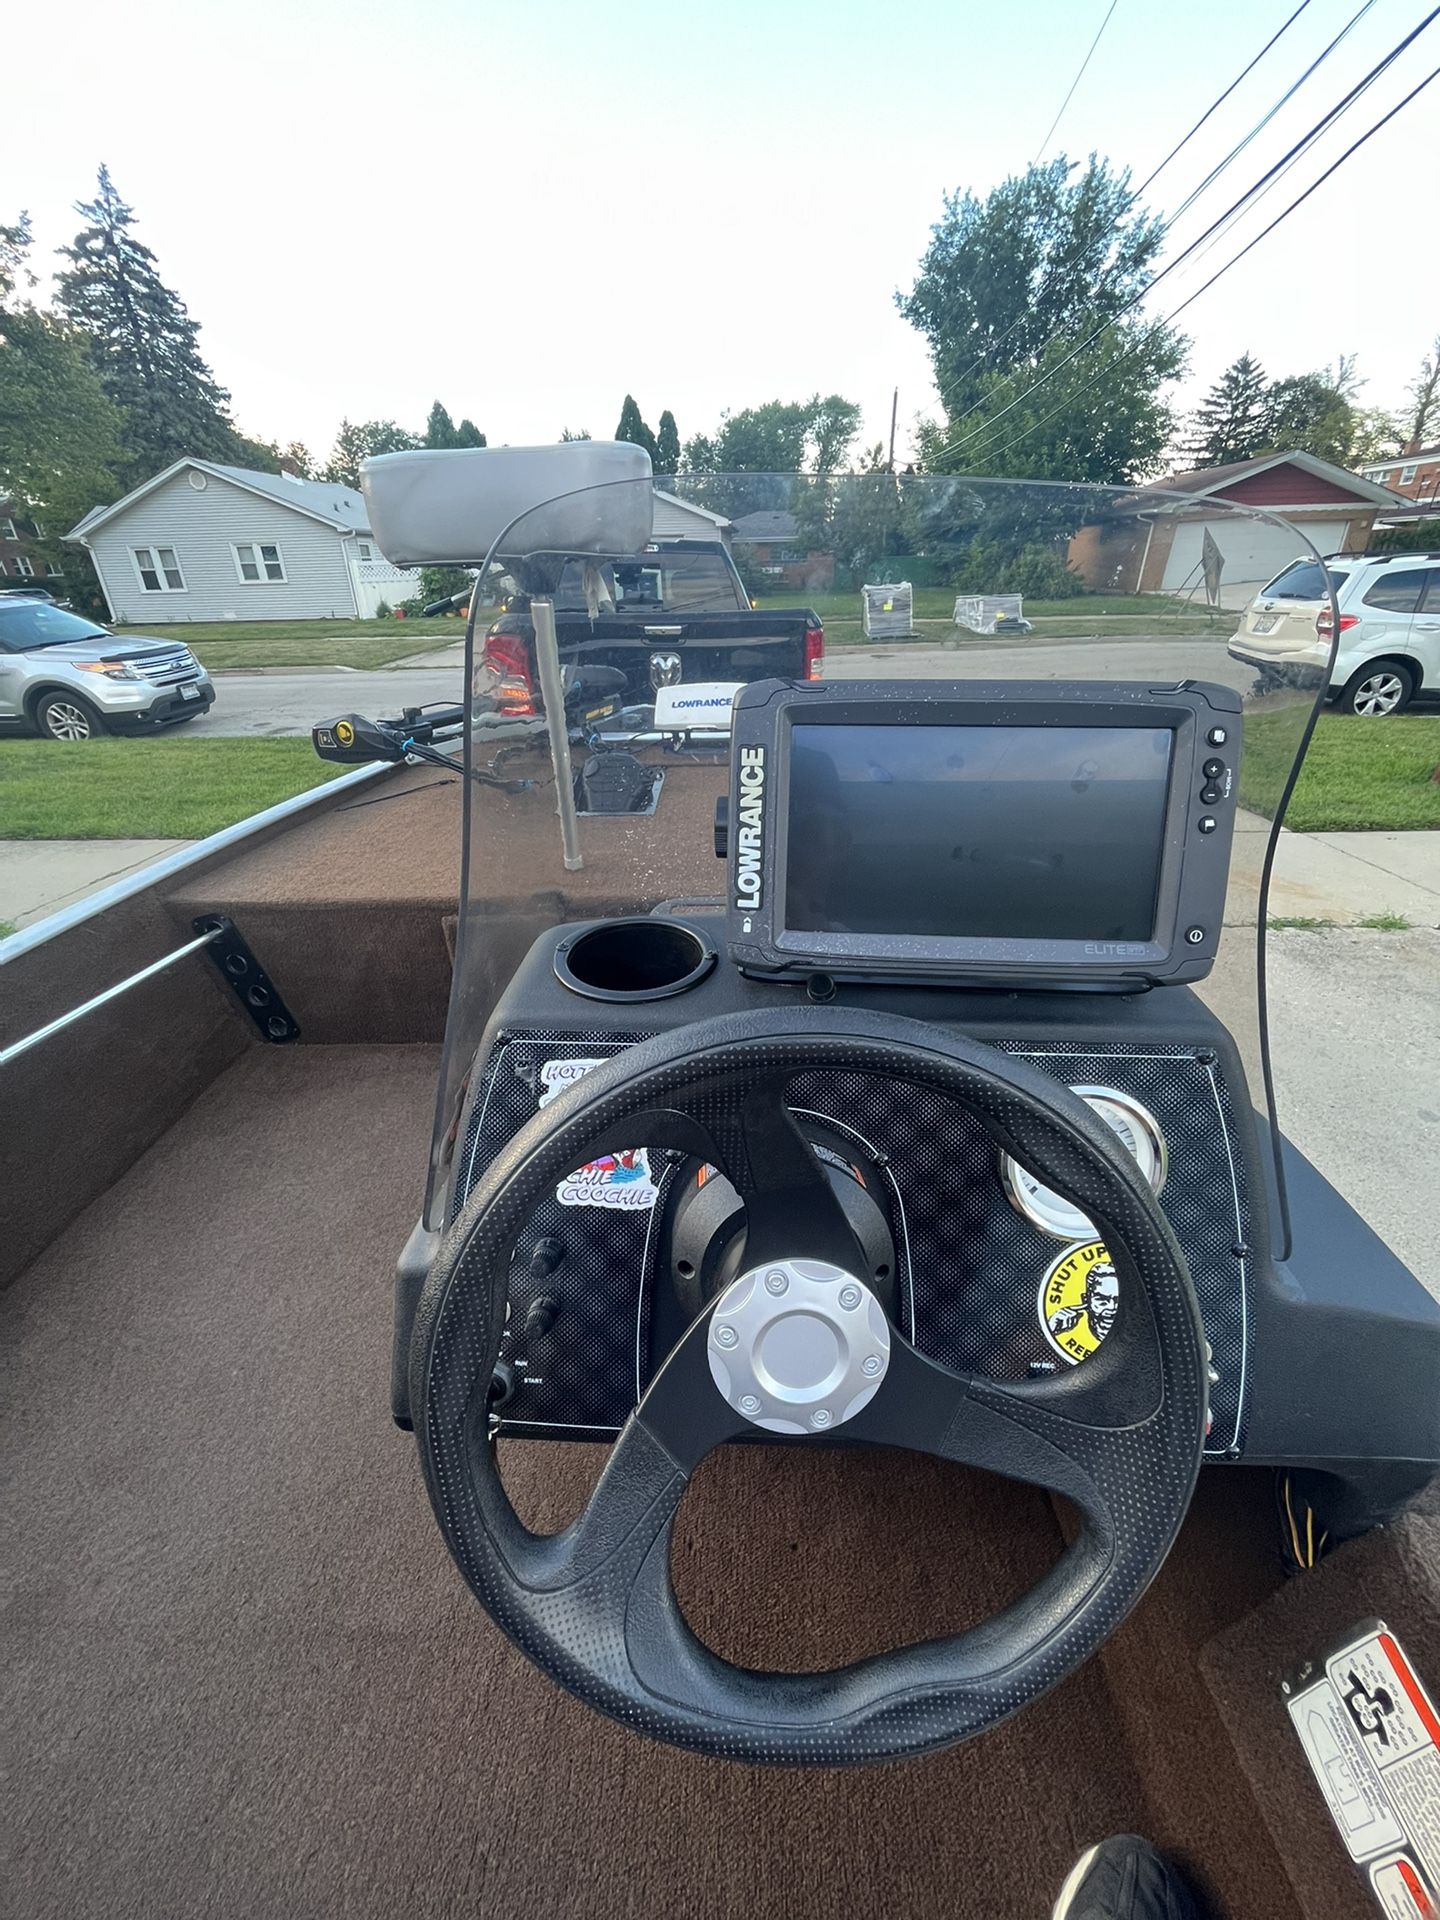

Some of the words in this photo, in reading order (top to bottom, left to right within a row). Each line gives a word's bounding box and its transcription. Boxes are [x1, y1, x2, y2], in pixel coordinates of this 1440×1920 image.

[671, 697, 733, 709] LOWRANCE
[737, 747, 765, 909] LOWRANCE
[1085, 943, 1126, 955] ELITE
[547, 1064, 598, 1080] HOTT
[1049, 1259, 1078, 1305] SHUT
[1081, 1246, 1107, 1262] UP
